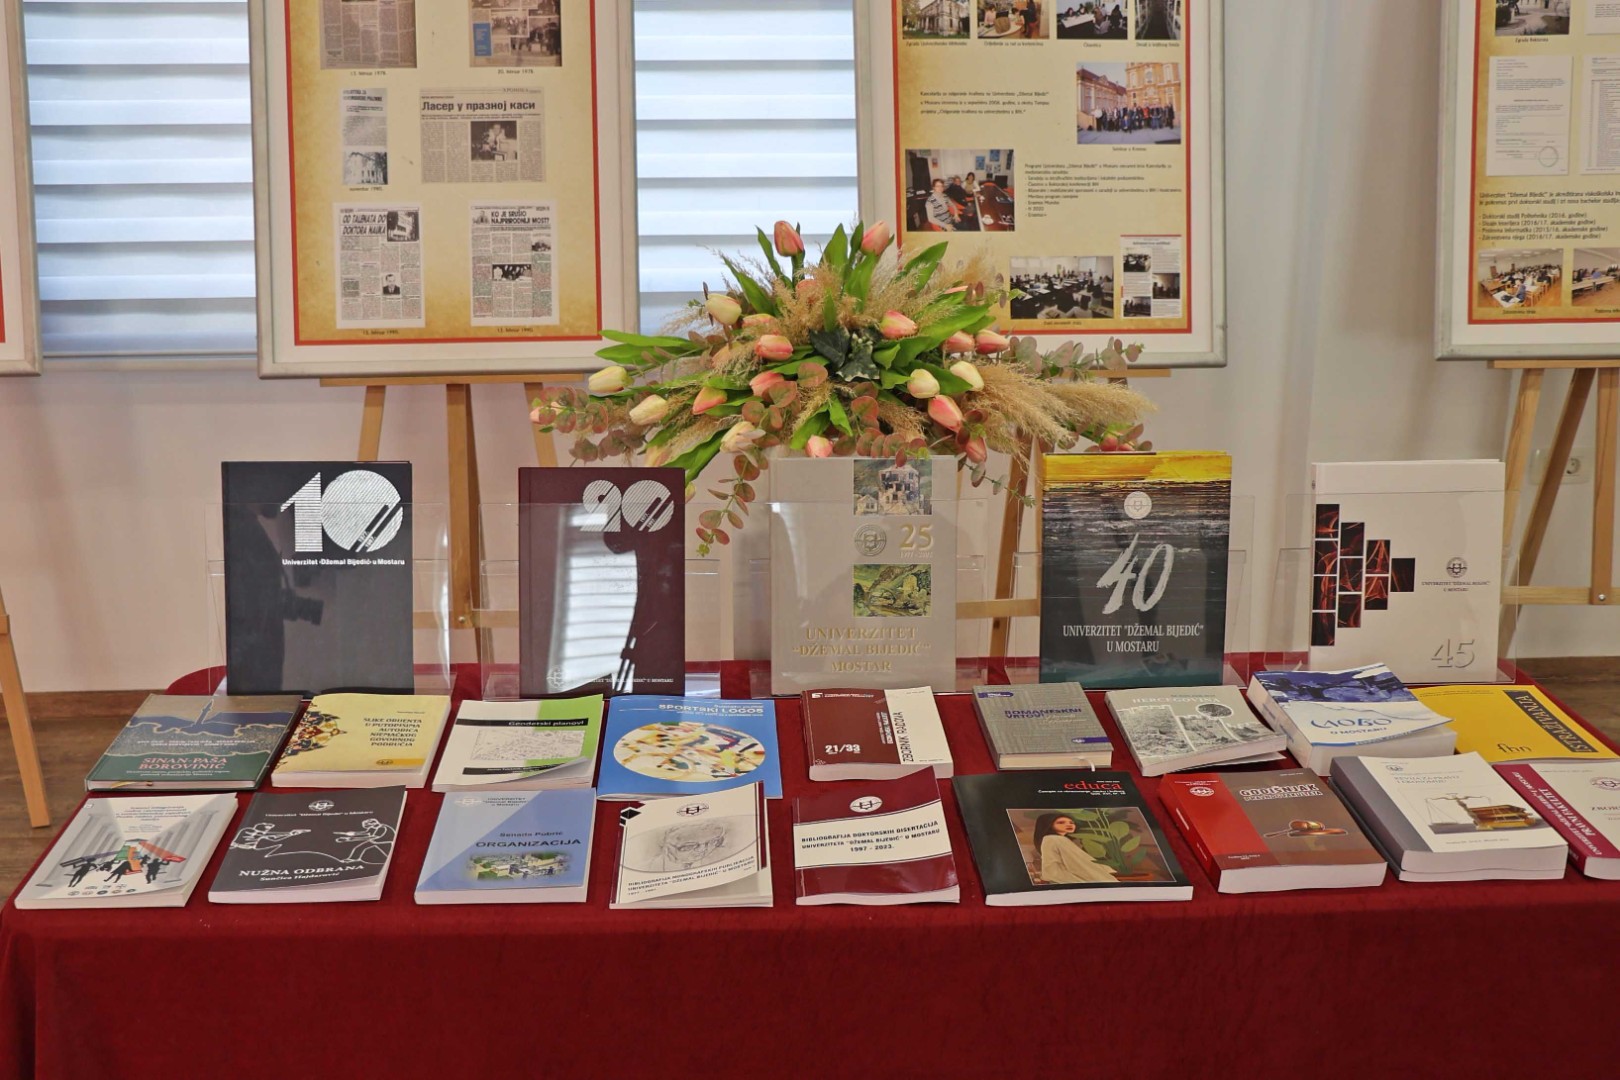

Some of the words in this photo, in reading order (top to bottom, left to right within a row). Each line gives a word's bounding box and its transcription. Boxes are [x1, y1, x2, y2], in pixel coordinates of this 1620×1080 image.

[422, 100, 455, 112] Ласер
[457, 103, 463, 112] у
[466, 100, 507, 111] празној
[510, 101, 536, 110] каси
[280, 470, 404, 553] 10
[899, 523, 934, 551] 25
[282, 558, 318, 566] Univerzitet
[377, 558, 405, 566] Mostaru
[1096, 532, 1175, 615] 40
[805, 627, 919, 641] UNIVERZITET
[1063, 625, 1122, 637] UNIVERZITET
[1124, 623, 1165, 637] "DŽEMAL
[1166, 622, 1204, 638] BIJEDIĆ"
[1106, 641, 1113, 653] U
[1115, 641, 1160, 653] MOSTARU
[1431, 638, 1475, 668] 45
[831, 661, 892, 673] MOSTAR
[659, 704, 718, 713] SPORTSKI
[893, 711, 907, 736] RADOVA
[1340, 726, 1388, 735] MOSTARU
[1515, 695, 1592, 753] ISTRAŽIVANJA
[825, 743, 861, 754] 21/33
[898, 735, 914, 762] ZBORNIK
[1063, 780, 1122, 790] educa
[1239, 783, 1320, 797] GODIŠNJAK
[801, 833, 851, 842] BIBLIOGRAFIJA
[852, 829, 895, 838] DOKTORSKIH
[896, 820, 938, 833] DISERTACIJA
[475, 839, 582, 848] ORGANIZACIJA
[801, 841, 845, 849] UNIVERZITETA
[911, 829, 940, 839] MOSTARU
[238, 869, 290, 877] NUŽNA
[293, 864, 365, 875] ODBRANA
